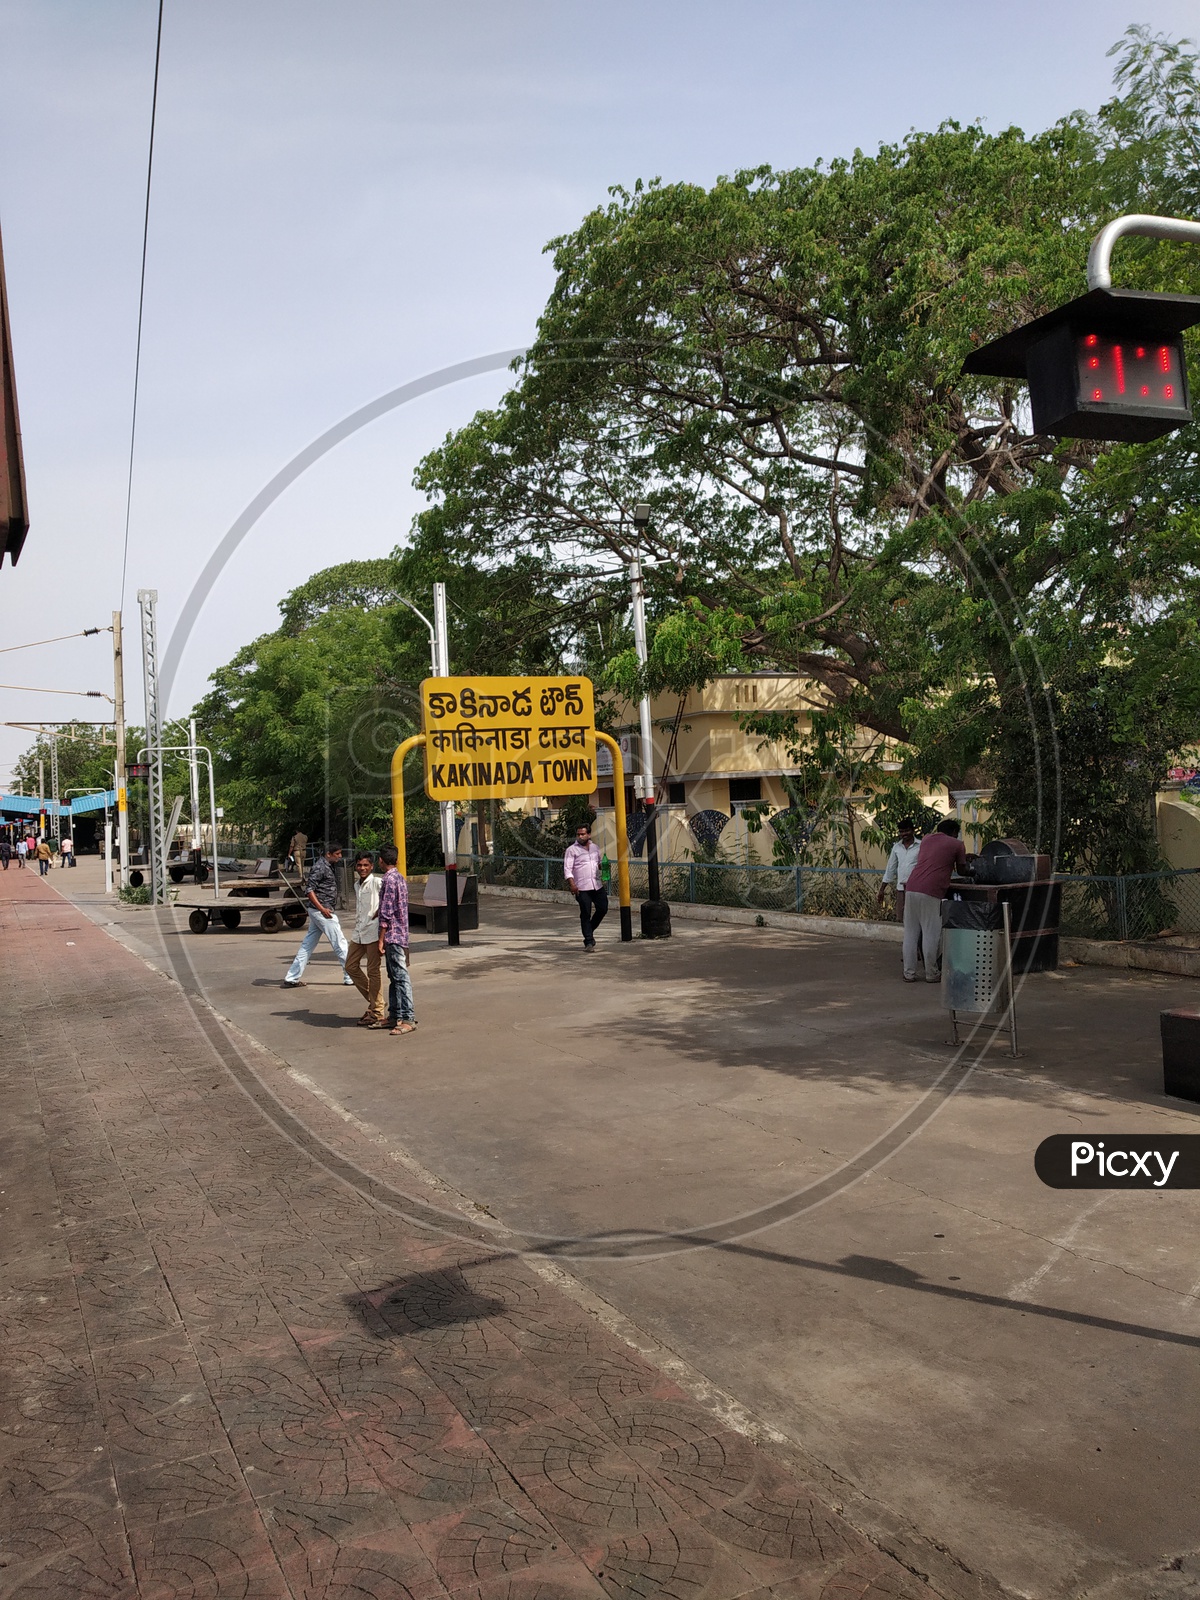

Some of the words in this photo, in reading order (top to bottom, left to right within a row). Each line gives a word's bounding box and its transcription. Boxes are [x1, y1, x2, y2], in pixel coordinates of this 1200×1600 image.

[429, 686, 533, 719] కాకినాడ
[540, 683, 584, 716] టౌన్
[430, 722, 532, 753] काकिनाडा
[538, 725, 591, 749] टाउन
[431, 760, 534, 788] KAKINADA
[538, 758, 593, 783] TOWN
